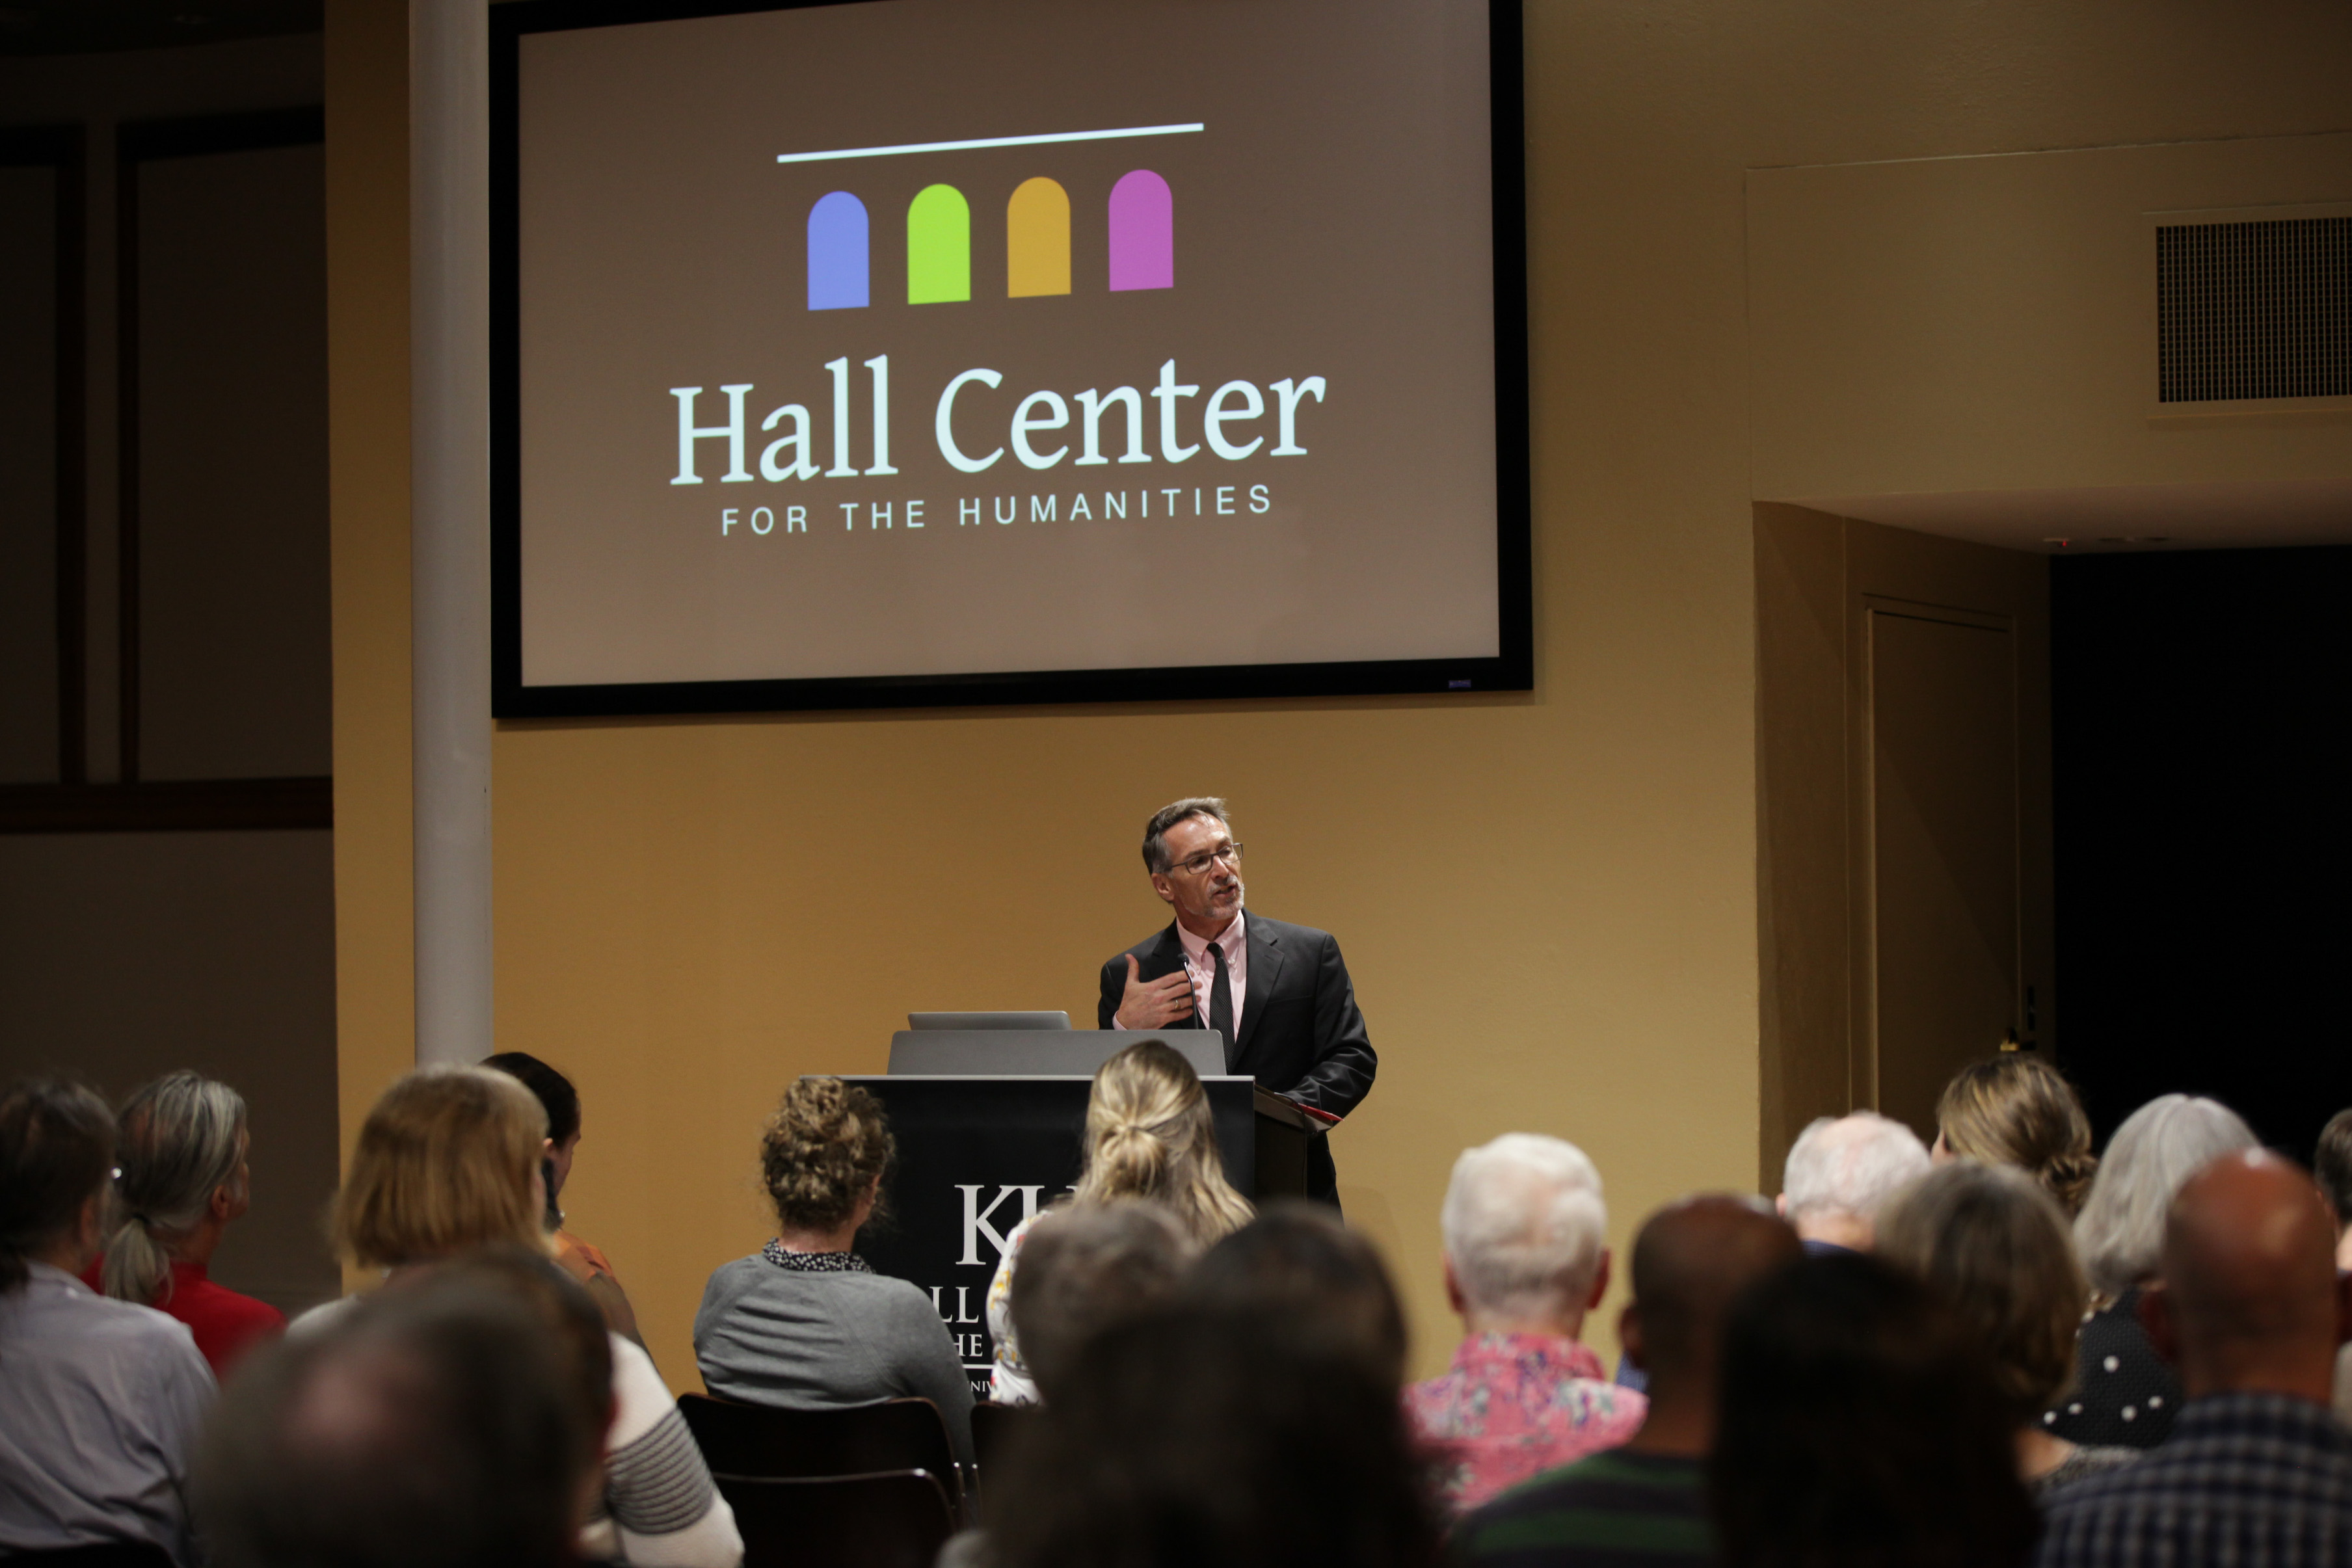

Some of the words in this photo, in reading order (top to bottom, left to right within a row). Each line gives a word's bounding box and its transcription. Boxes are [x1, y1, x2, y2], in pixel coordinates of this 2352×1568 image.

[669, 354, 899, 485] Hall
[935, 358, 1327, 473] Center
[721, 505, 808, 536] FOR
[838, 500, 926, 531] THE
[959, 484, 1271, 526] HUMANITIES
[929, 1286, 979, 1323] LL
[953, 1333, 983, 1357] HE
